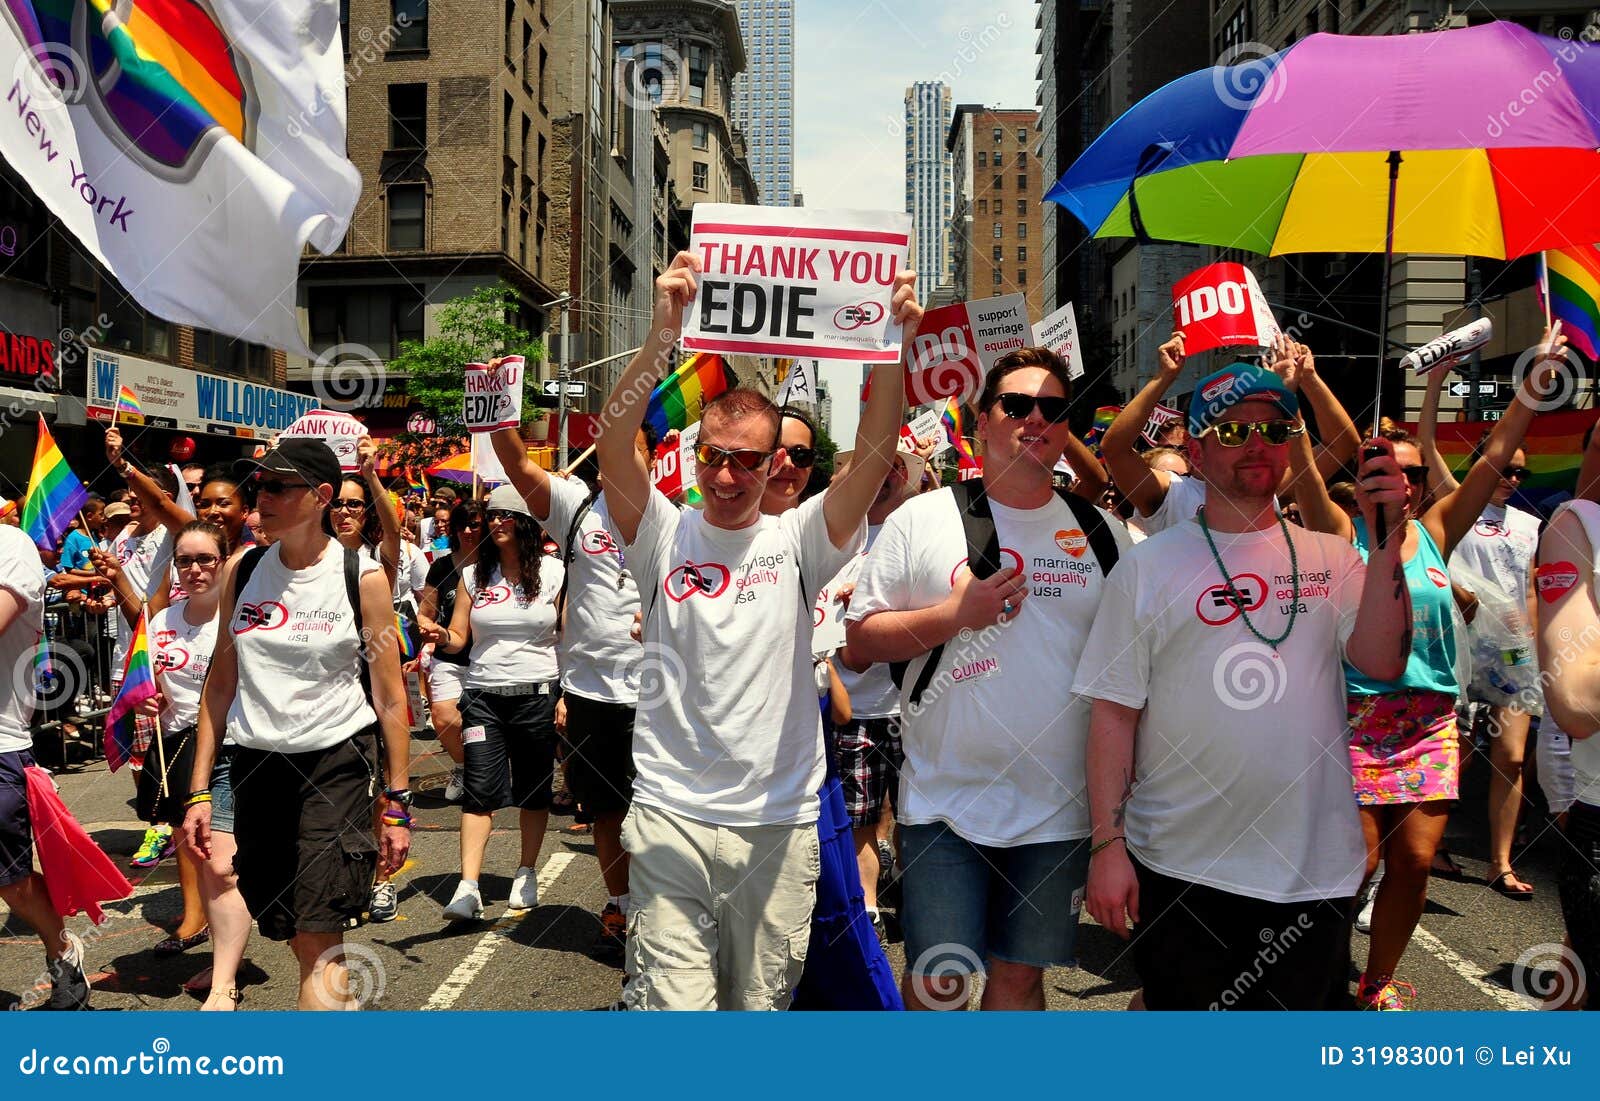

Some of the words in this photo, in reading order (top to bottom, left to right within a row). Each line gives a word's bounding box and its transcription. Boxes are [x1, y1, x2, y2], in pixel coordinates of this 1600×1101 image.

[7, 79, 59, 162] New
[69, 159, 135, 233] York
[699, 242, 821, 281] THANK
[828, 249, 898, 286] YOU
[700, 280, 818, 340] EDIE
[978, 306, 1018, 323] support
[978, 323, 1024, 337] marriage
[1040, 316, 1069, 339] support
[984, 338, 1025, 353] equality
[96, 360, 116, 400] W
[466, 374, 503, 393] HANK
[464, 394, 501, 424] EDIE
[1483, 411, 1489, 421] E
[286, 419, 327, 435] HANK
[332, 420, 363, 436] YOU
[1033, 556, 1092, 574] marriage
[1033, 571, 1088, 588] equality
[1033, 585, 1062, 599] usa
[291, 622, 335, 636] equality
[288, 633, 309, 643] usa
[952, 658, 997, 680] QUINN
